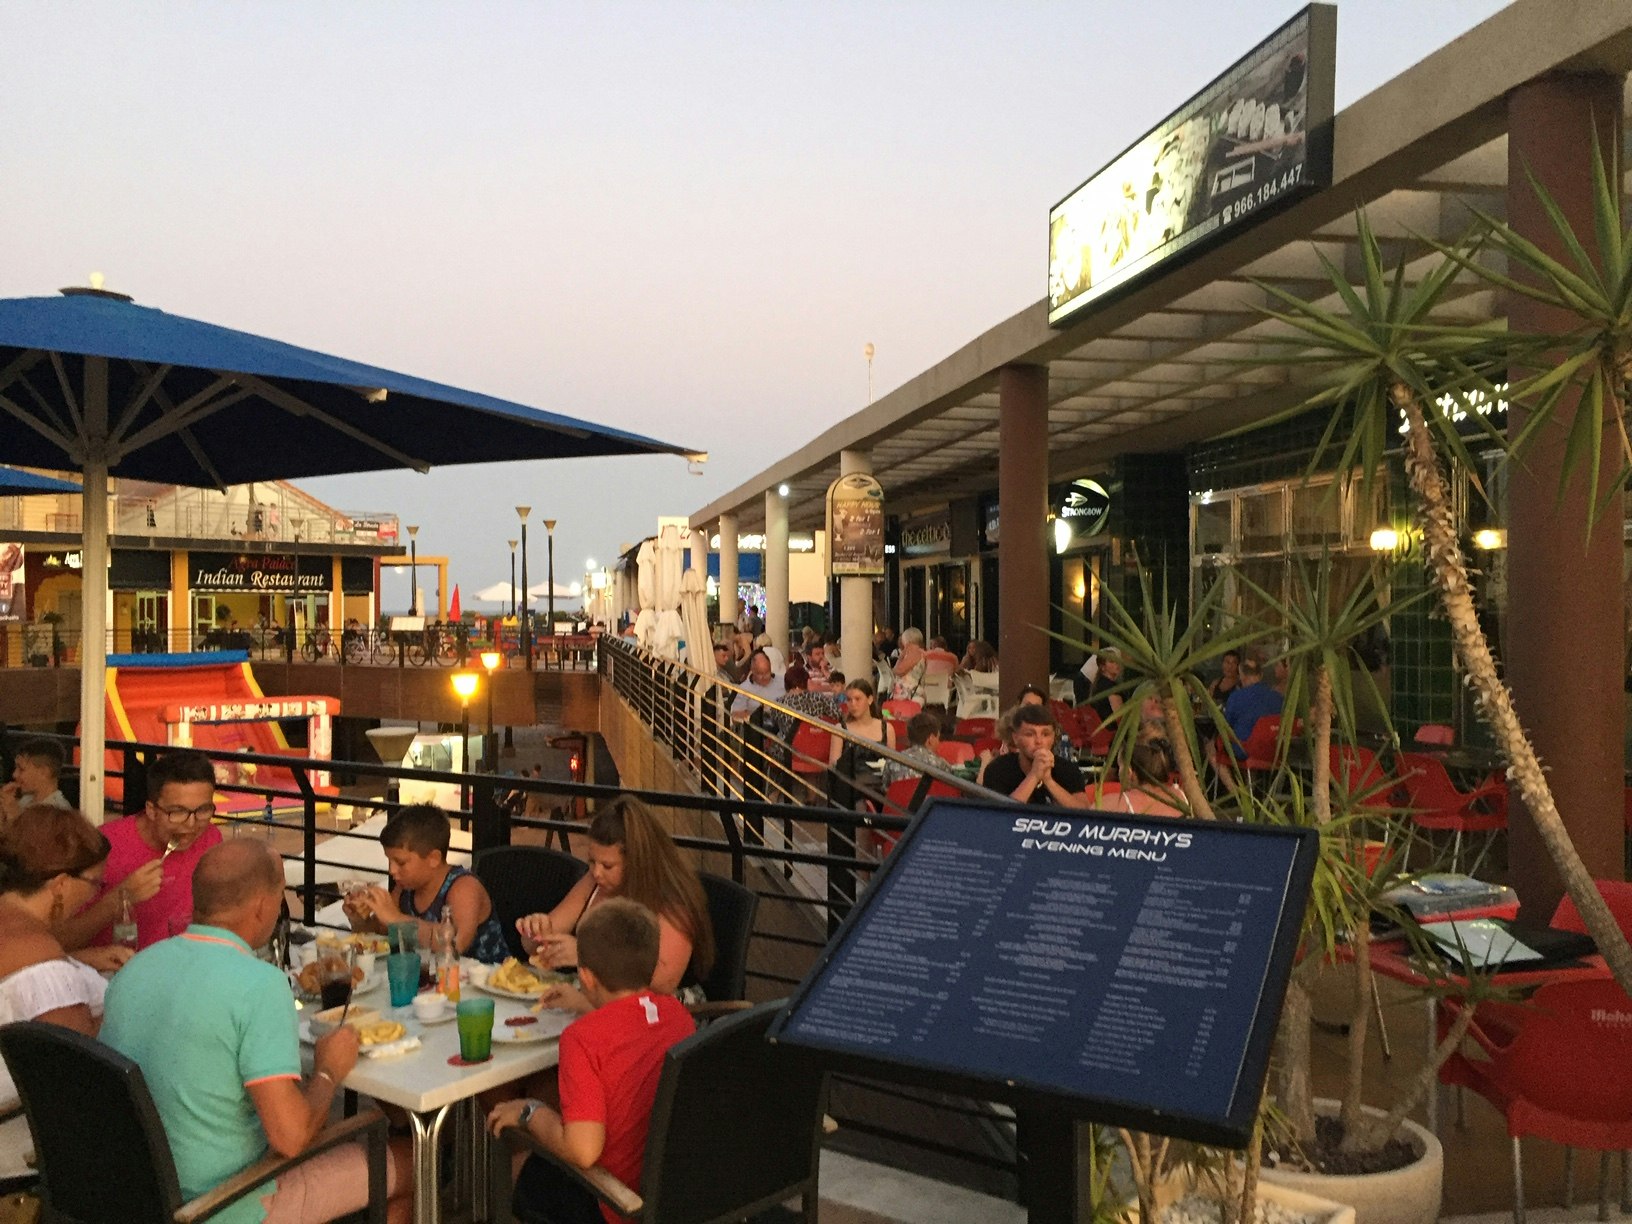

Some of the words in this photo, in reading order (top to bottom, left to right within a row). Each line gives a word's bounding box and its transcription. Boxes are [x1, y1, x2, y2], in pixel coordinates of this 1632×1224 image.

[1234, 163, 1303, 218] 966.184.447
[1061, 505, 1103, 518] STRONGBOW
[196, 568, 243, 586] Indian
[1012, 817, 1072, 837] SPUD
[1078, 824, 1193, 849] MURPHYS
[1021, 838, 1104, 857] EVENING
[1107, 847, 1167, 863] MENU
